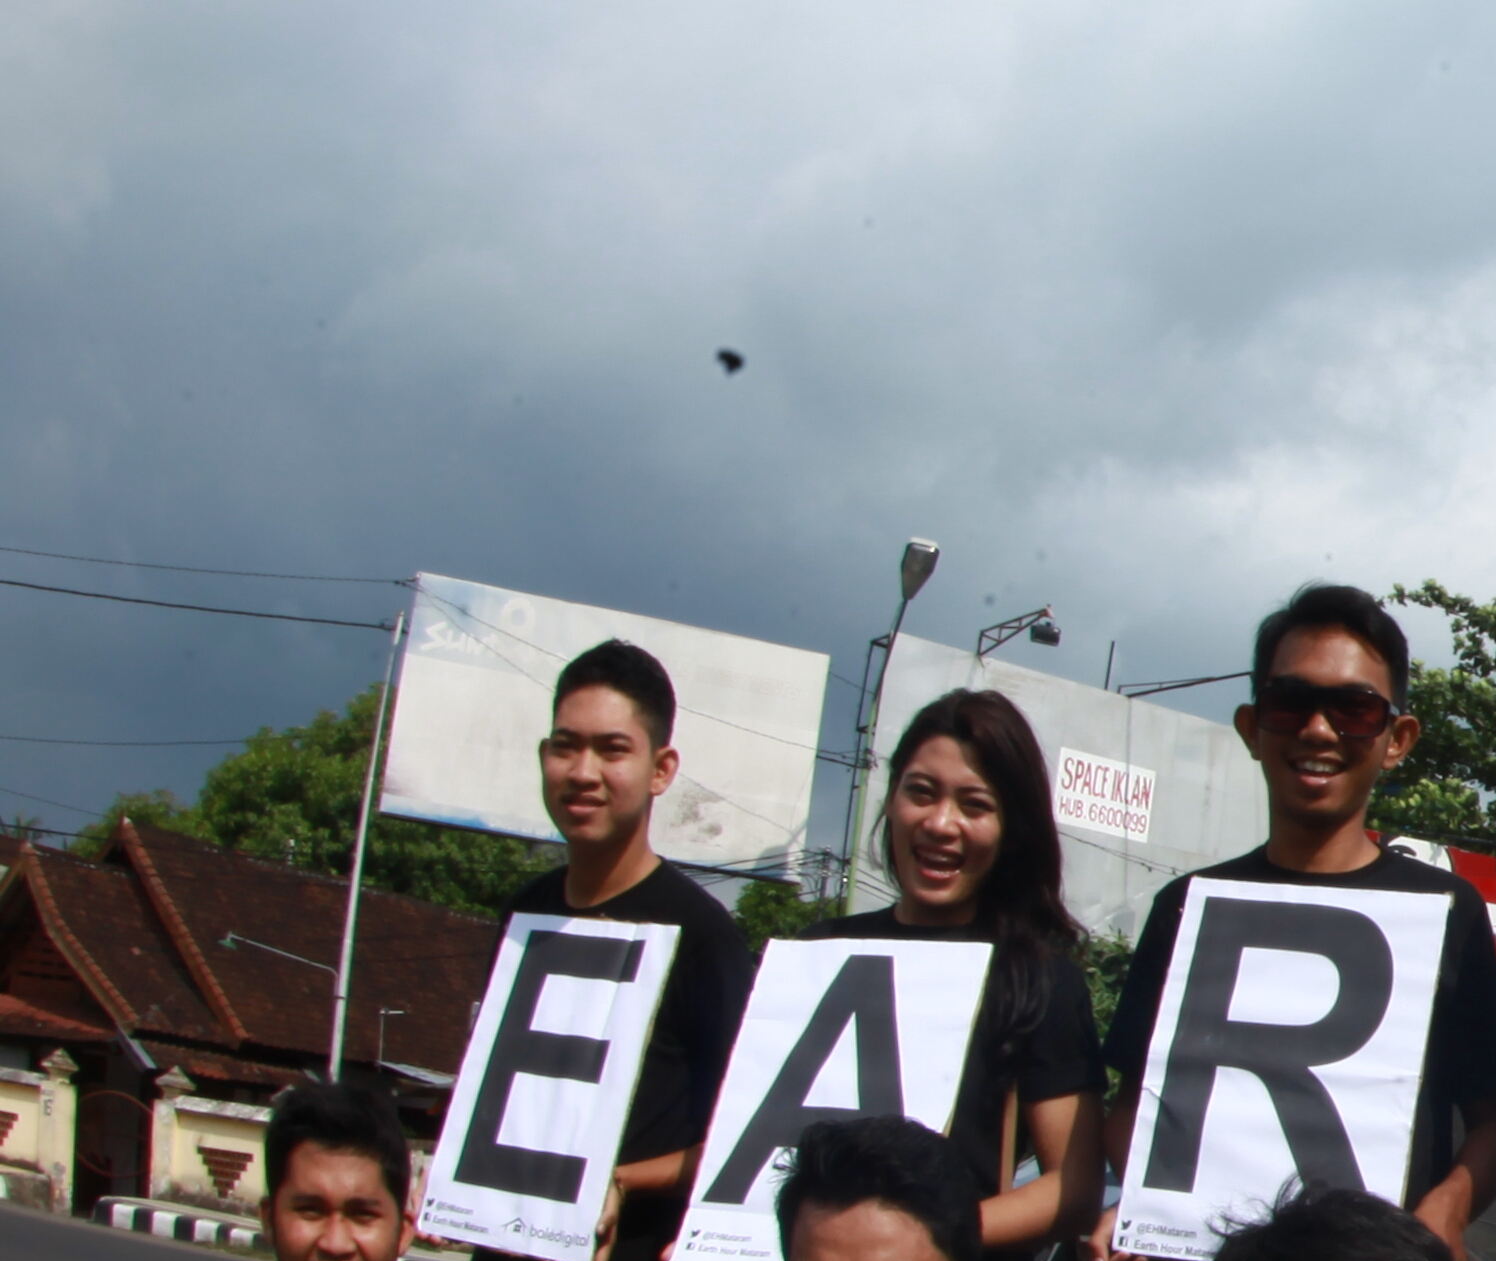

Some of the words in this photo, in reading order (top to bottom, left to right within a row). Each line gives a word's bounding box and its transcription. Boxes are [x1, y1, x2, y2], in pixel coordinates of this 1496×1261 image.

[1061, 757, 1110, 798] SPACE
[1110, 769, 1152, 810] IKLAN
[454, 929, 644, 1203] E
[703, 955, 905, 1203] A
[1142, 896, 1393, 1193] R
[1134, 1239, 1158, 1250] Earth
